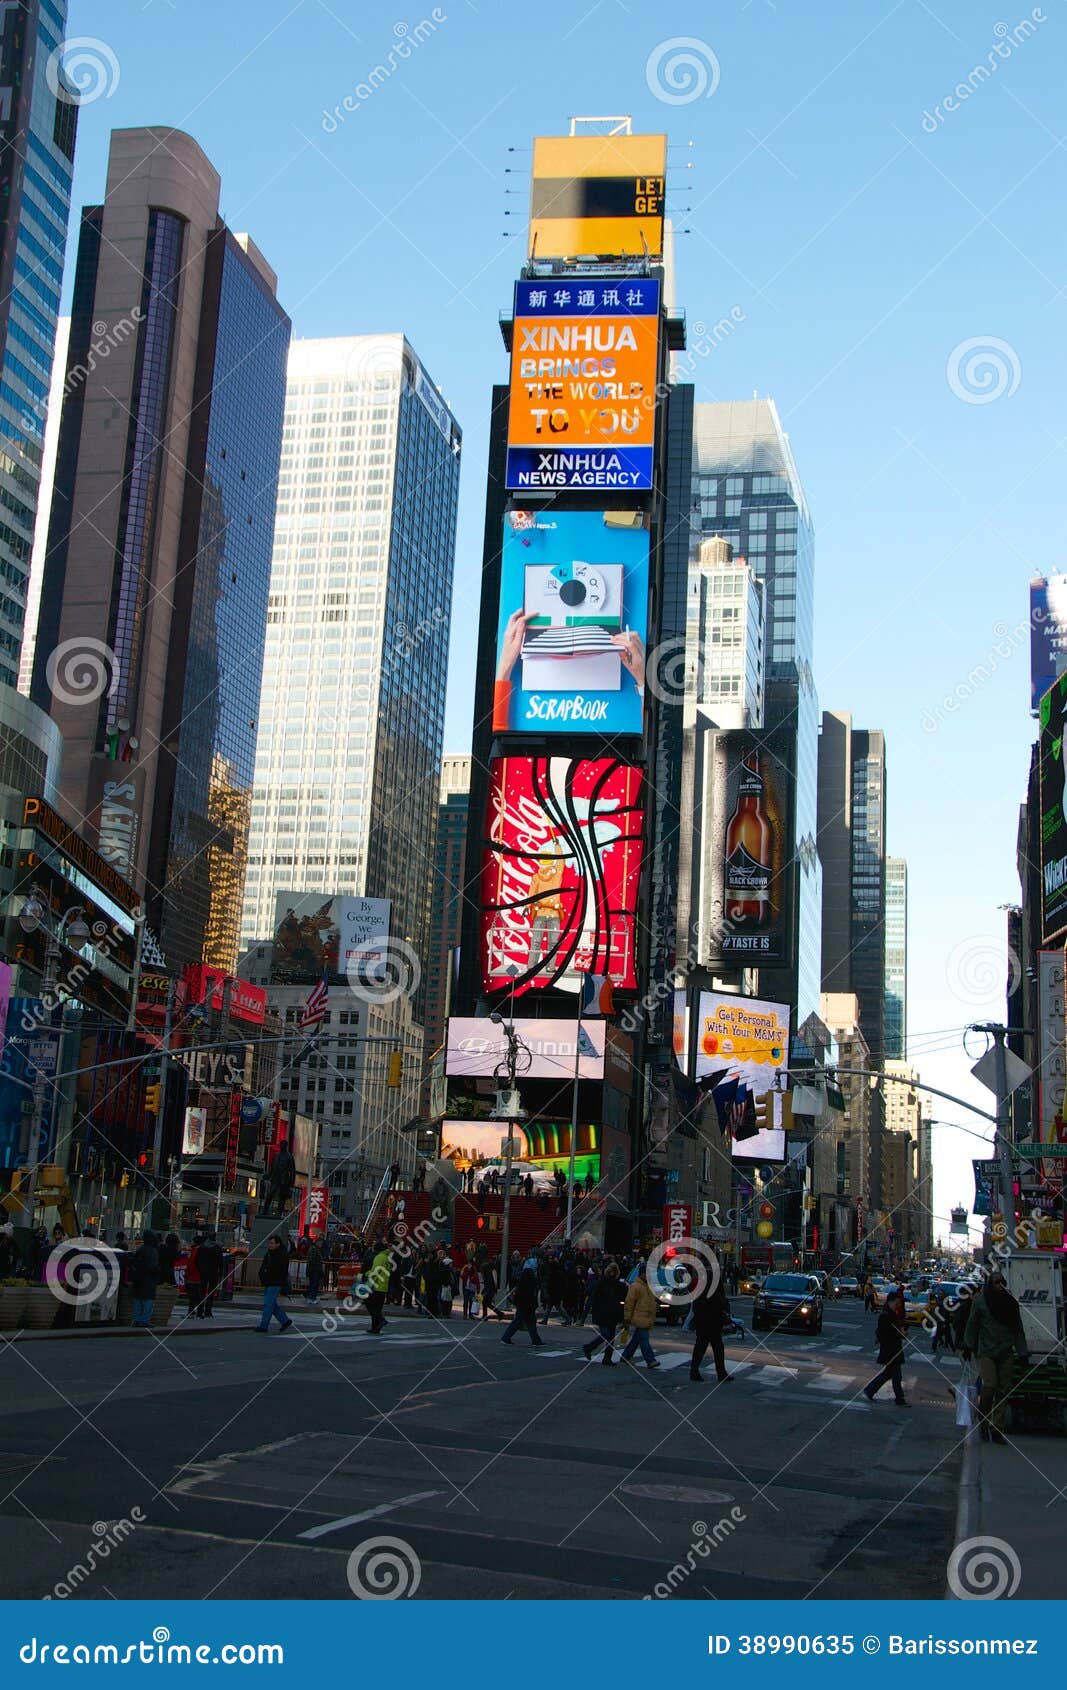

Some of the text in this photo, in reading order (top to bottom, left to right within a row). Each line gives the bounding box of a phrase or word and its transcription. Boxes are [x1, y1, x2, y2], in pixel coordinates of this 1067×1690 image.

[635, 196, 664, 213] GE
[529, 290, 644, 307] 新华通讯社
[520, 326, 637, 351] XINHUA
[520, 358, 616, 378] BRINGS
[525, 382, 644, 400] THE WORLD
[530, 408, 640, 434] TO YOU
[537, 454, 622, 471] XINHUA
[518, 471, 640, 485] NEWS AGENCY
[361, 901, 373, 913] By
[346, 911, 385, 926] George,
[359, 924, 372, 933] we
[722, 937, 770, 949] #TASTE IS
[718, 1009, 775, 1028] Get Personal
[706, 1021, 729, 1034] With
[731, 1024, 752, 1038] Your
[310, 1190, 324, 1224] tkts
[669, 1207, 687, 1243] tkts
